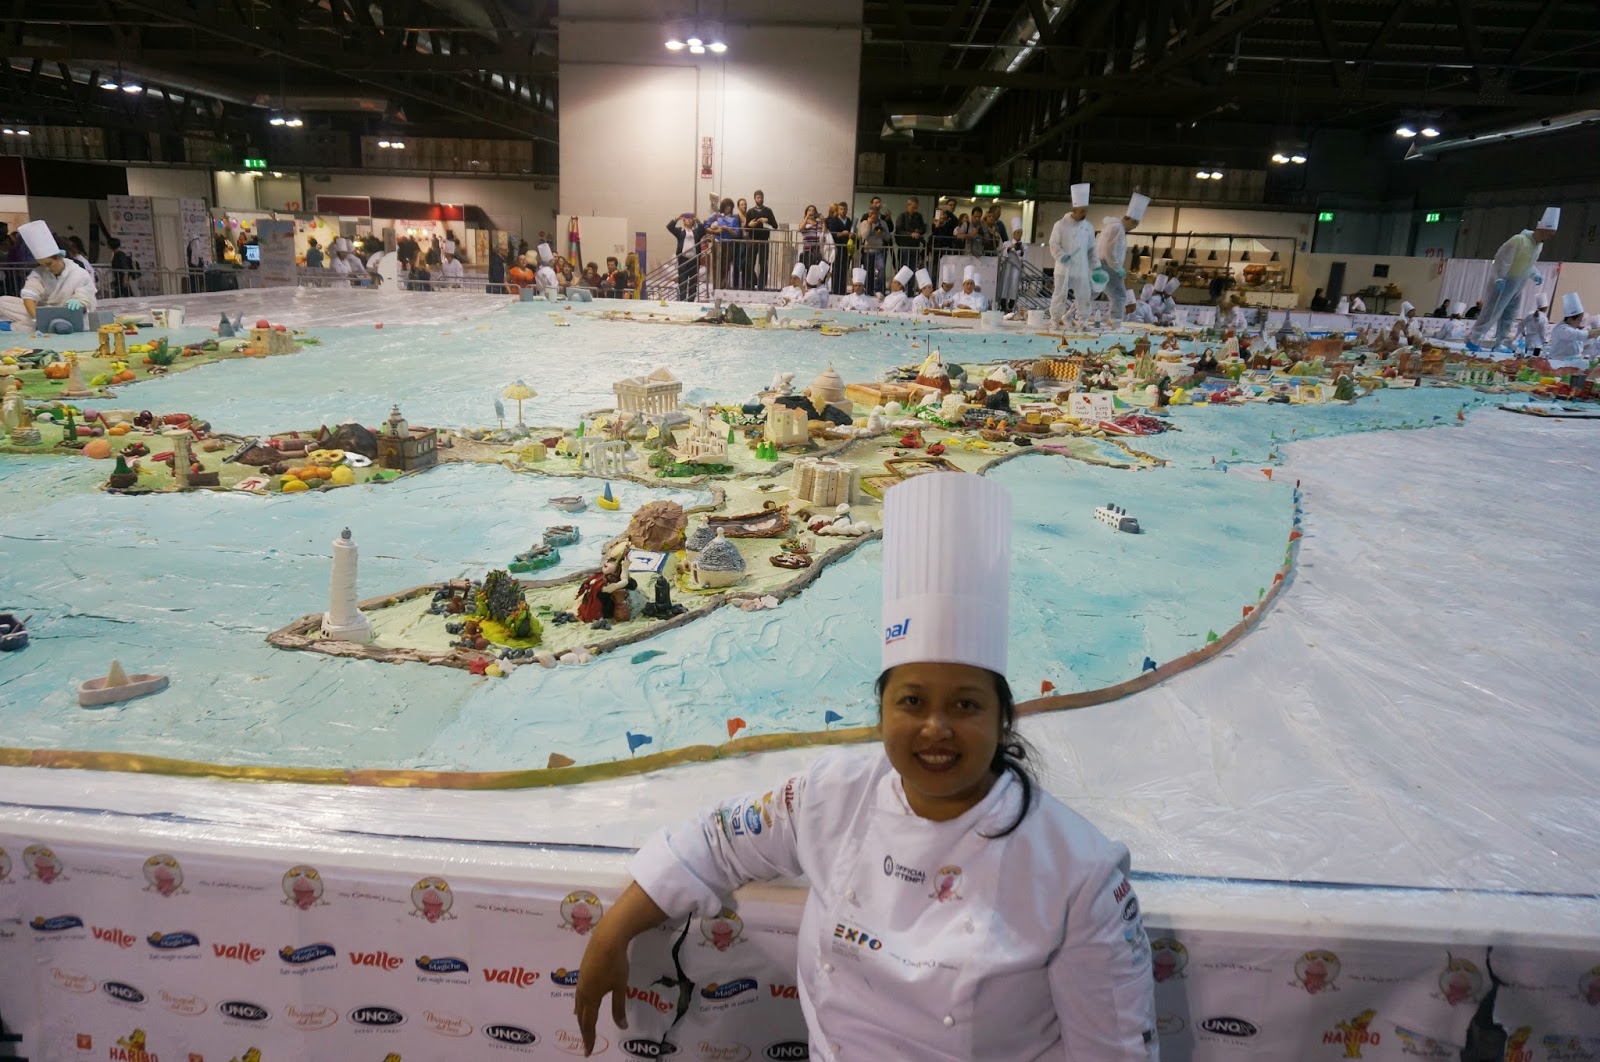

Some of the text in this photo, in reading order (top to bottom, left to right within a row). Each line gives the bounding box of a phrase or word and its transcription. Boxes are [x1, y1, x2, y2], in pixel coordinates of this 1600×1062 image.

[895, 863, 927, 878] OFFICIAL
[834, 923, 883, 950] EXPO
[428, 962, 461, 972] Magiche
[714, 982, 750, 998] Magiche
[354, 1010, 401, 1023] UNOX
[488, 1027, 531, 1043] UNOX
[1322, 1031, 1382, 1046] HARIBO
